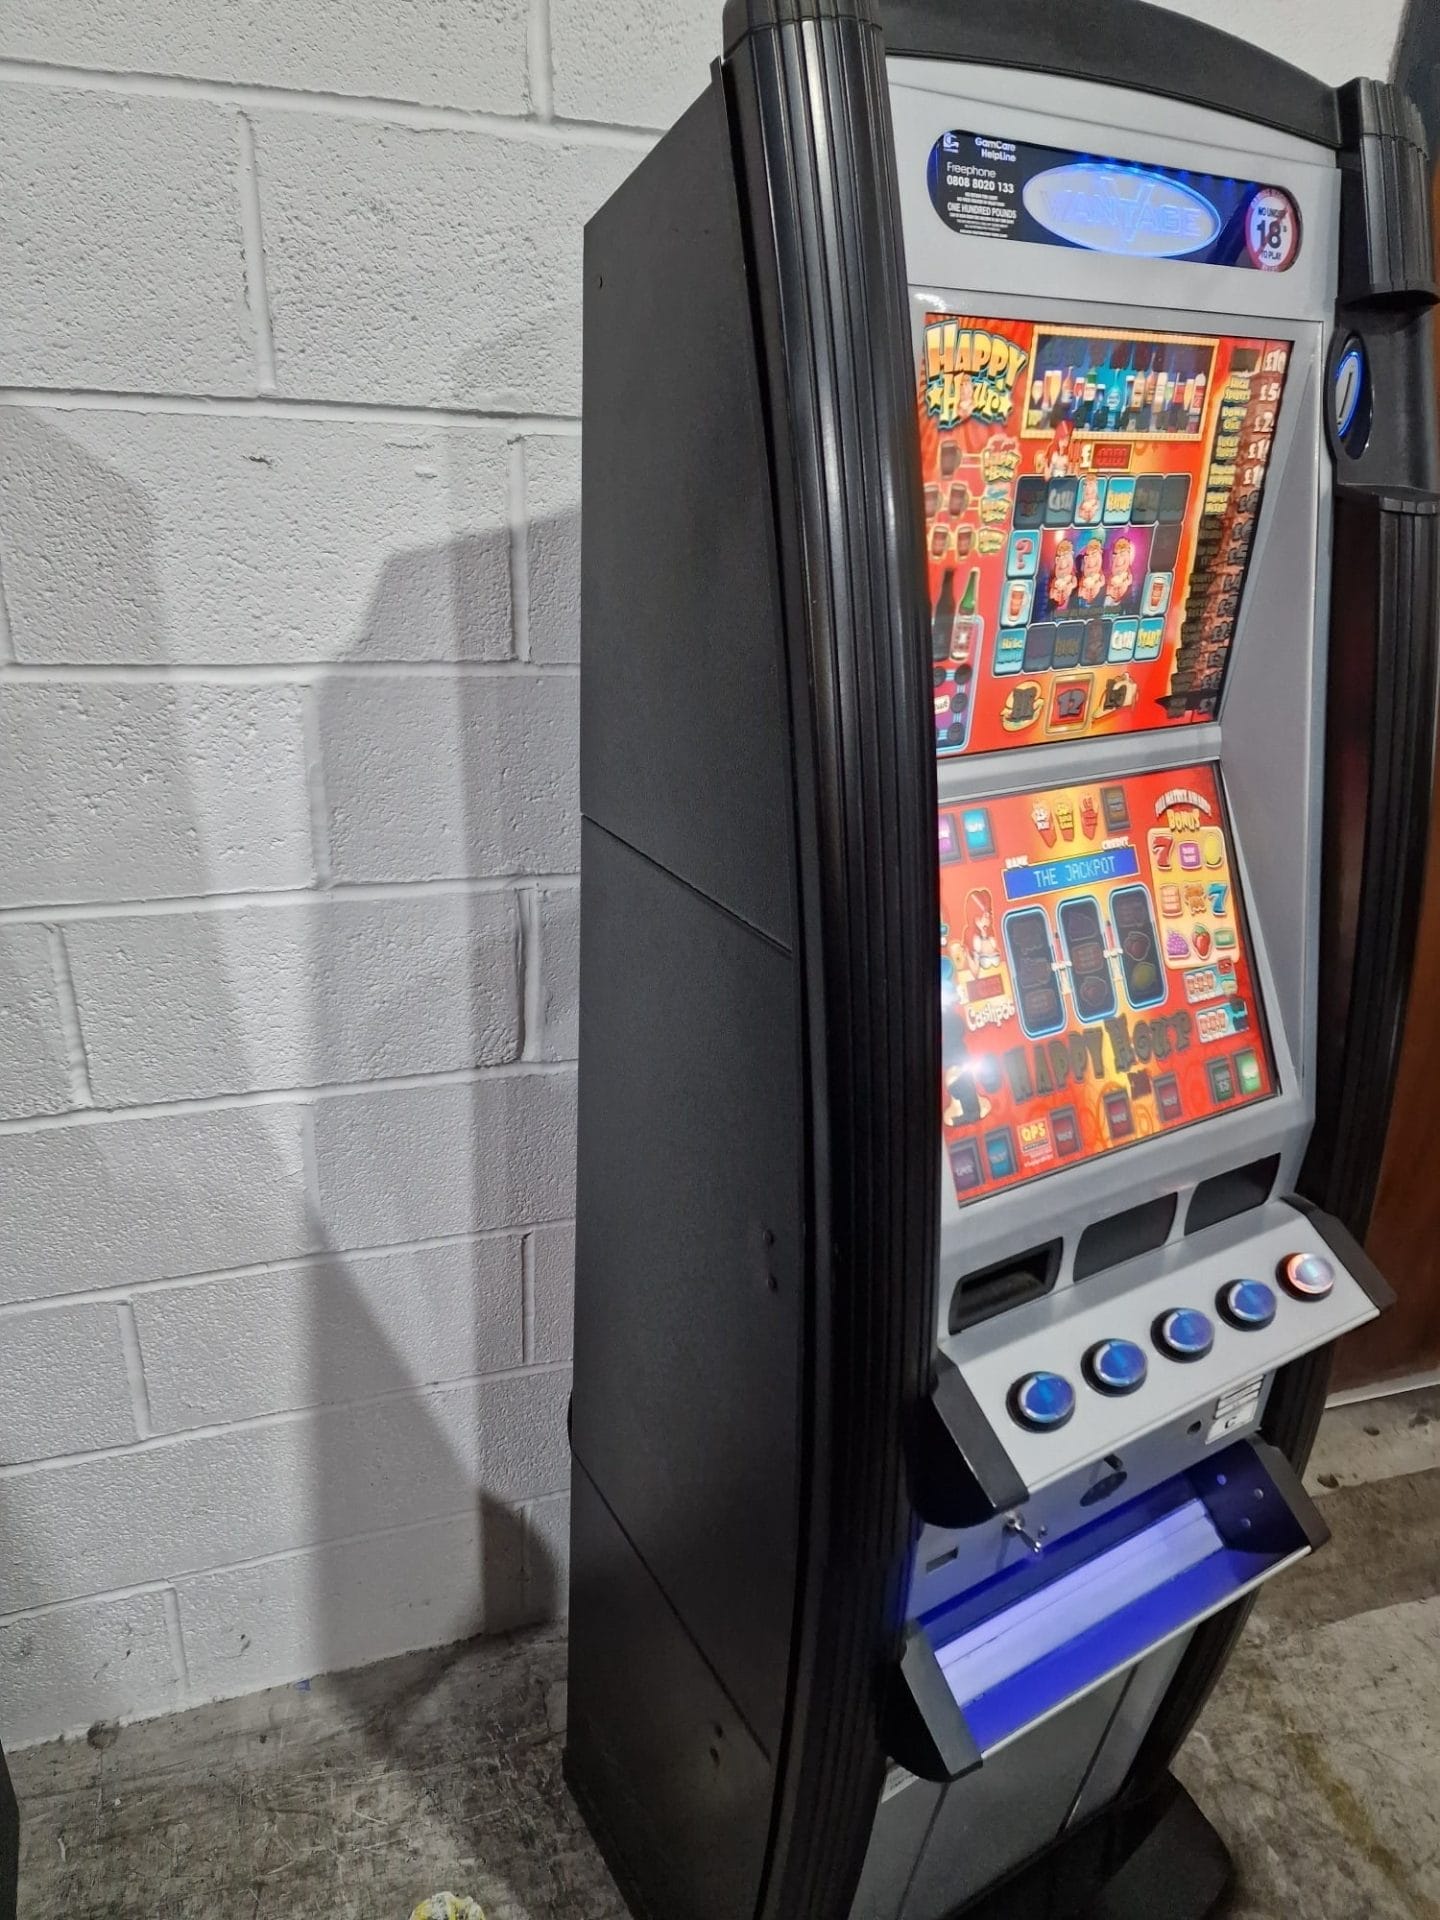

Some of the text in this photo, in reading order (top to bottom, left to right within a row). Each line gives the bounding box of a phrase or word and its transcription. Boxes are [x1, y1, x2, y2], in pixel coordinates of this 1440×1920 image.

[975, 137, 1016, 152] GamCare
[946, 161, 996, 178] Freephone
[946, 174, 1015, 194] 0808 8020 133
[947, 201, 961, 213] ONE
[961, 203, 992, 216] HUNDRED
[991, 207, 1017, 219] POUNDS
[925, 319, 1028, 388] HAPPY
[1034, 855, 1118, 888] THE JACKPOT
